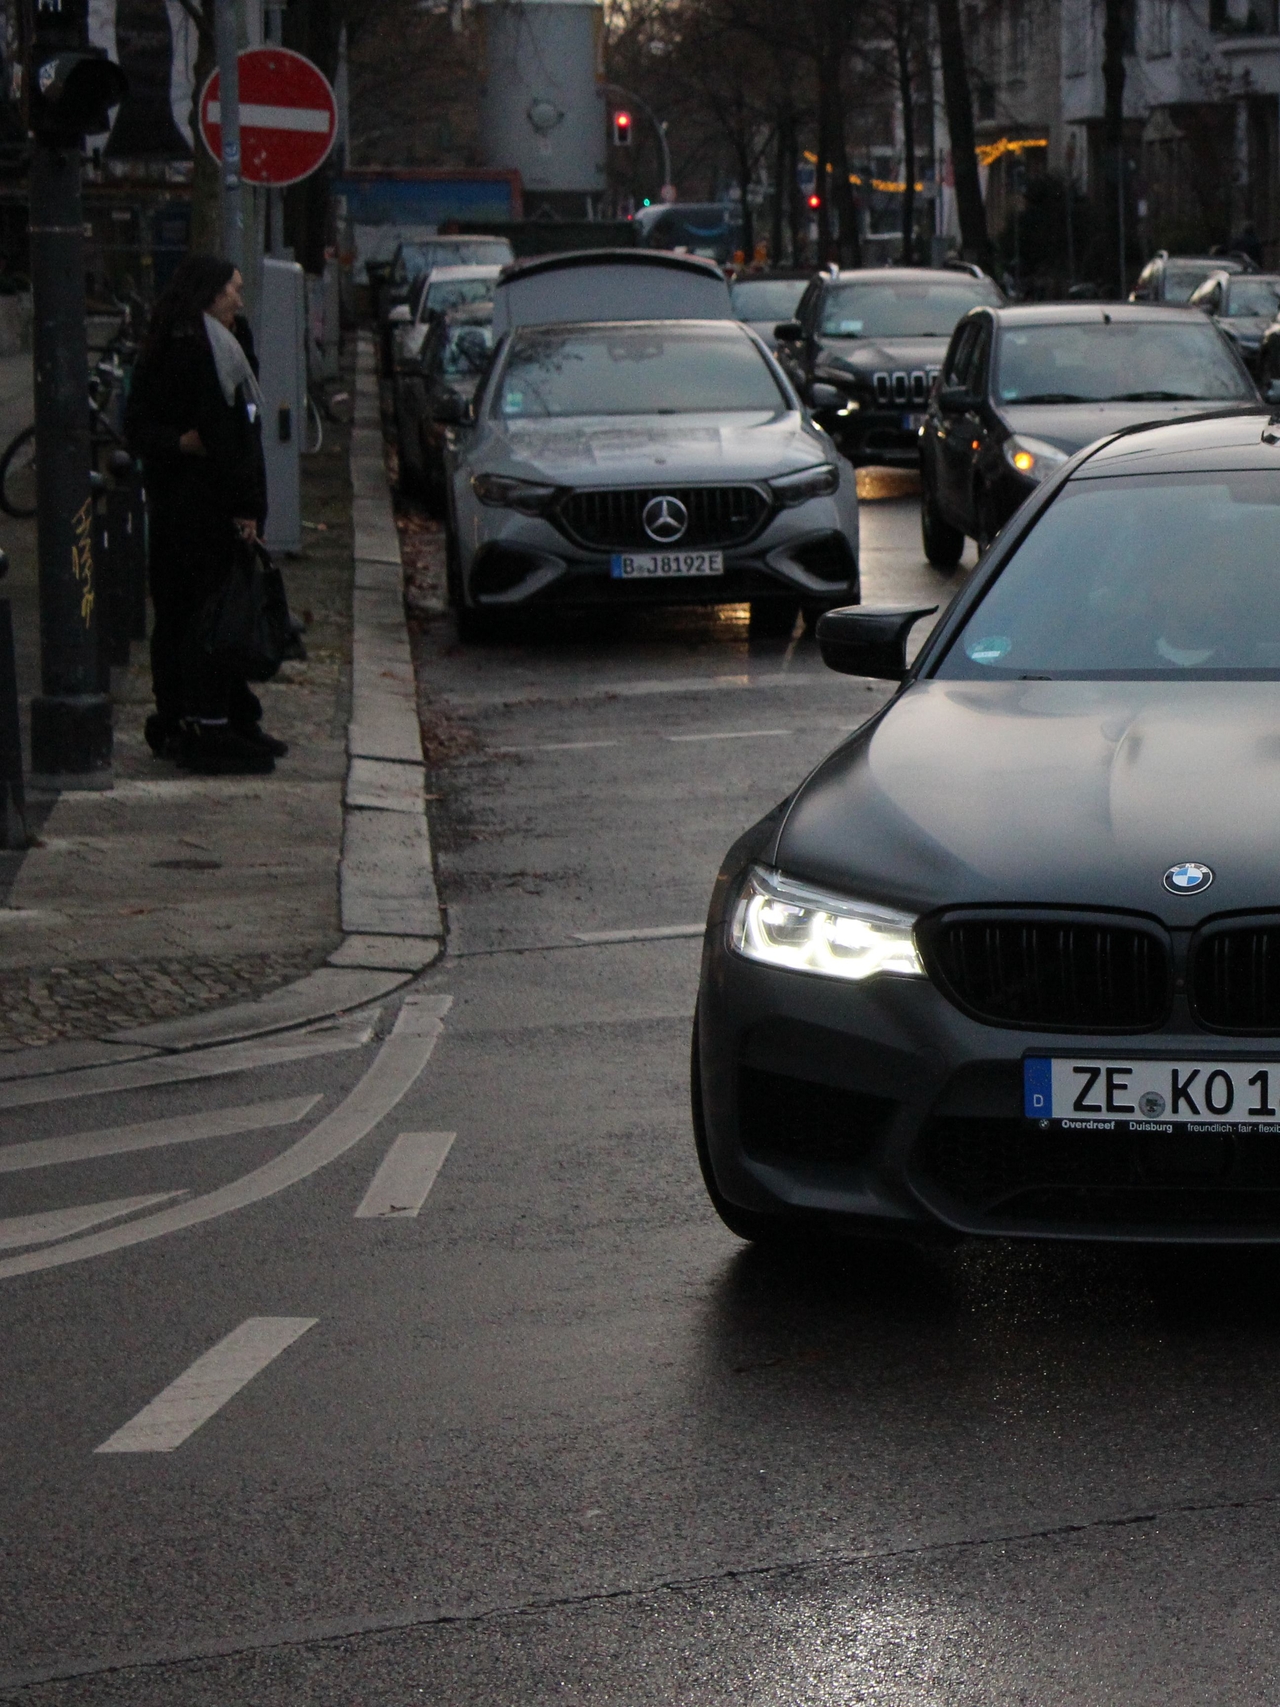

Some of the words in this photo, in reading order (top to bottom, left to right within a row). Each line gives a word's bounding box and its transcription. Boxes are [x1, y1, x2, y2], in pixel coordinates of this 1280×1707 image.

[623, 558, 634, 574] B
[1073, 1066, 1135, 1113] ZE
[1033, 1094, 1044, 1108] D
[1061, 1119, 1116, 1131] Overdreef
[1129, 1121, 1173, 1133] Duisburg
[1187, 1123, 1232, 1133] freundlich
[1238, 1123, 1253, 1133] fair
